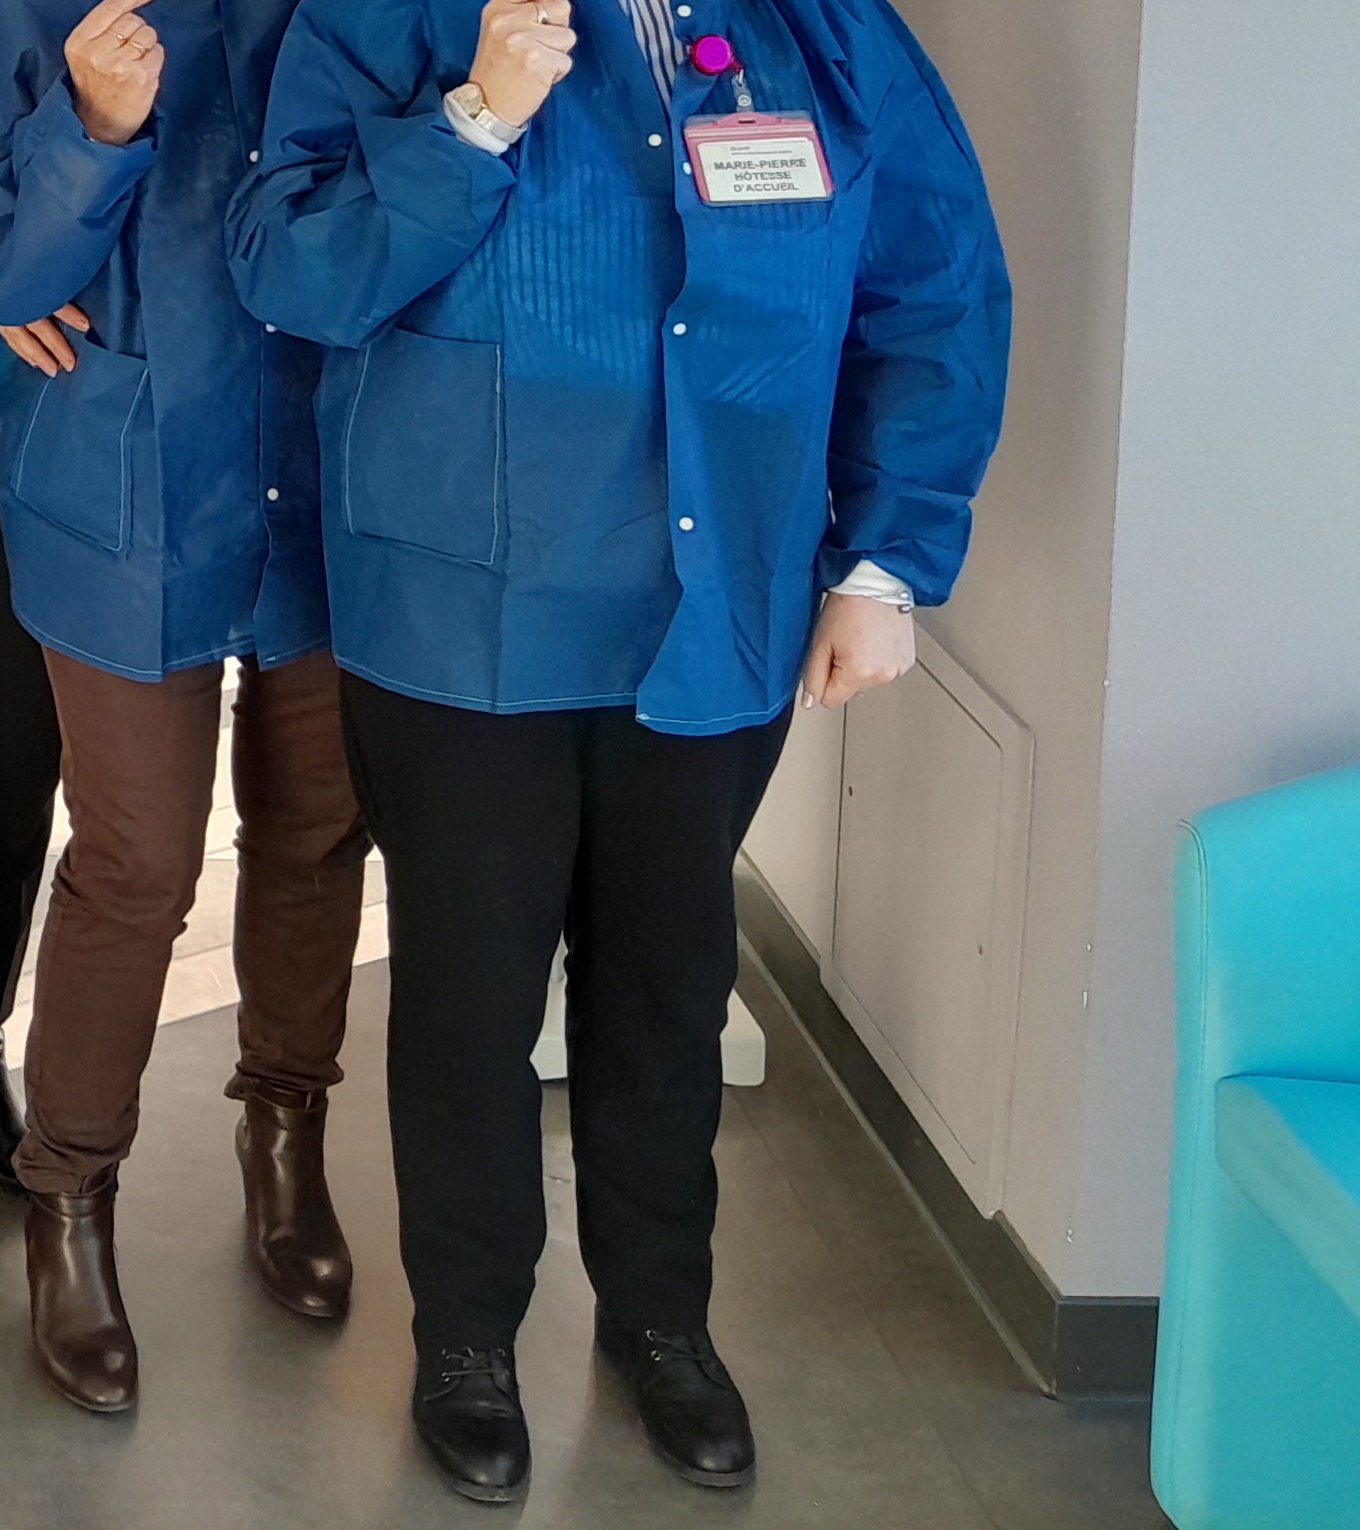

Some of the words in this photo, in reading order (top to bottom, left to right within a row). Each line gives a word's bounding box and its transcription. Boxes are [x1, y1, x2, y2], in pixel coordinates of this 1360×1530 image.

[713, 158, 807, 170] MARIE-PIERRE
[734, 171, 792, 182] HÔTESSE
[733, 183, 799, 193] D'ACCUEIL
